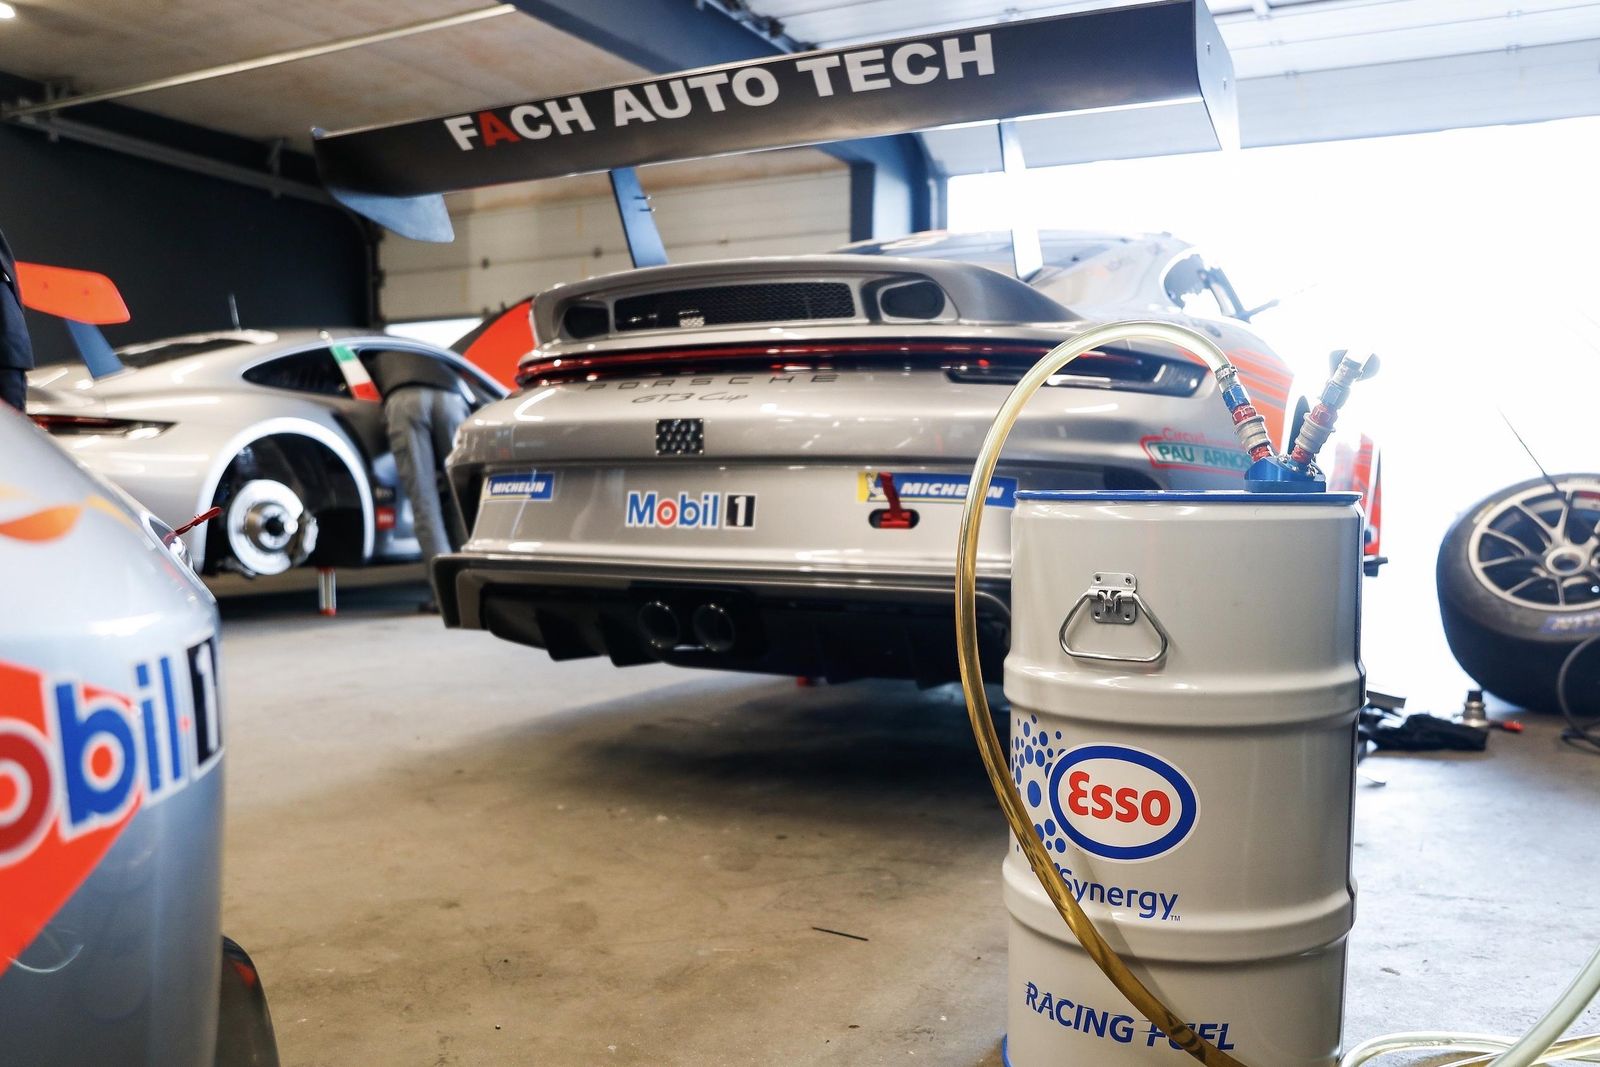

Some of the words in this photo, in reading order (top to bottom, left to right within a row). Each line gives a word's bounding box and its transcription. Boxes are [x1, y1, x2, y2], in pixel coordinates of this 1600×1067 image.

[444, 94, 596, 152] FACH
[613, 67, 780, 127] AUTO
[796, 33, 996, 97] TECH
[585, 374, 840, 391] PORSCHE
[632, 393, 695, 405] GT3
[698, 390, 750, 405] Cup
[1157, 445, 1195, 462] PAU
[492, 480, 545, 495] MICHELIN
[899, 481, 1005, 499] MICHEN
[627, 492, 719, 528] Mobil
[1060, 867, 1179, 921] Synergy
[1024, 981, 1135, 1043] RACING
